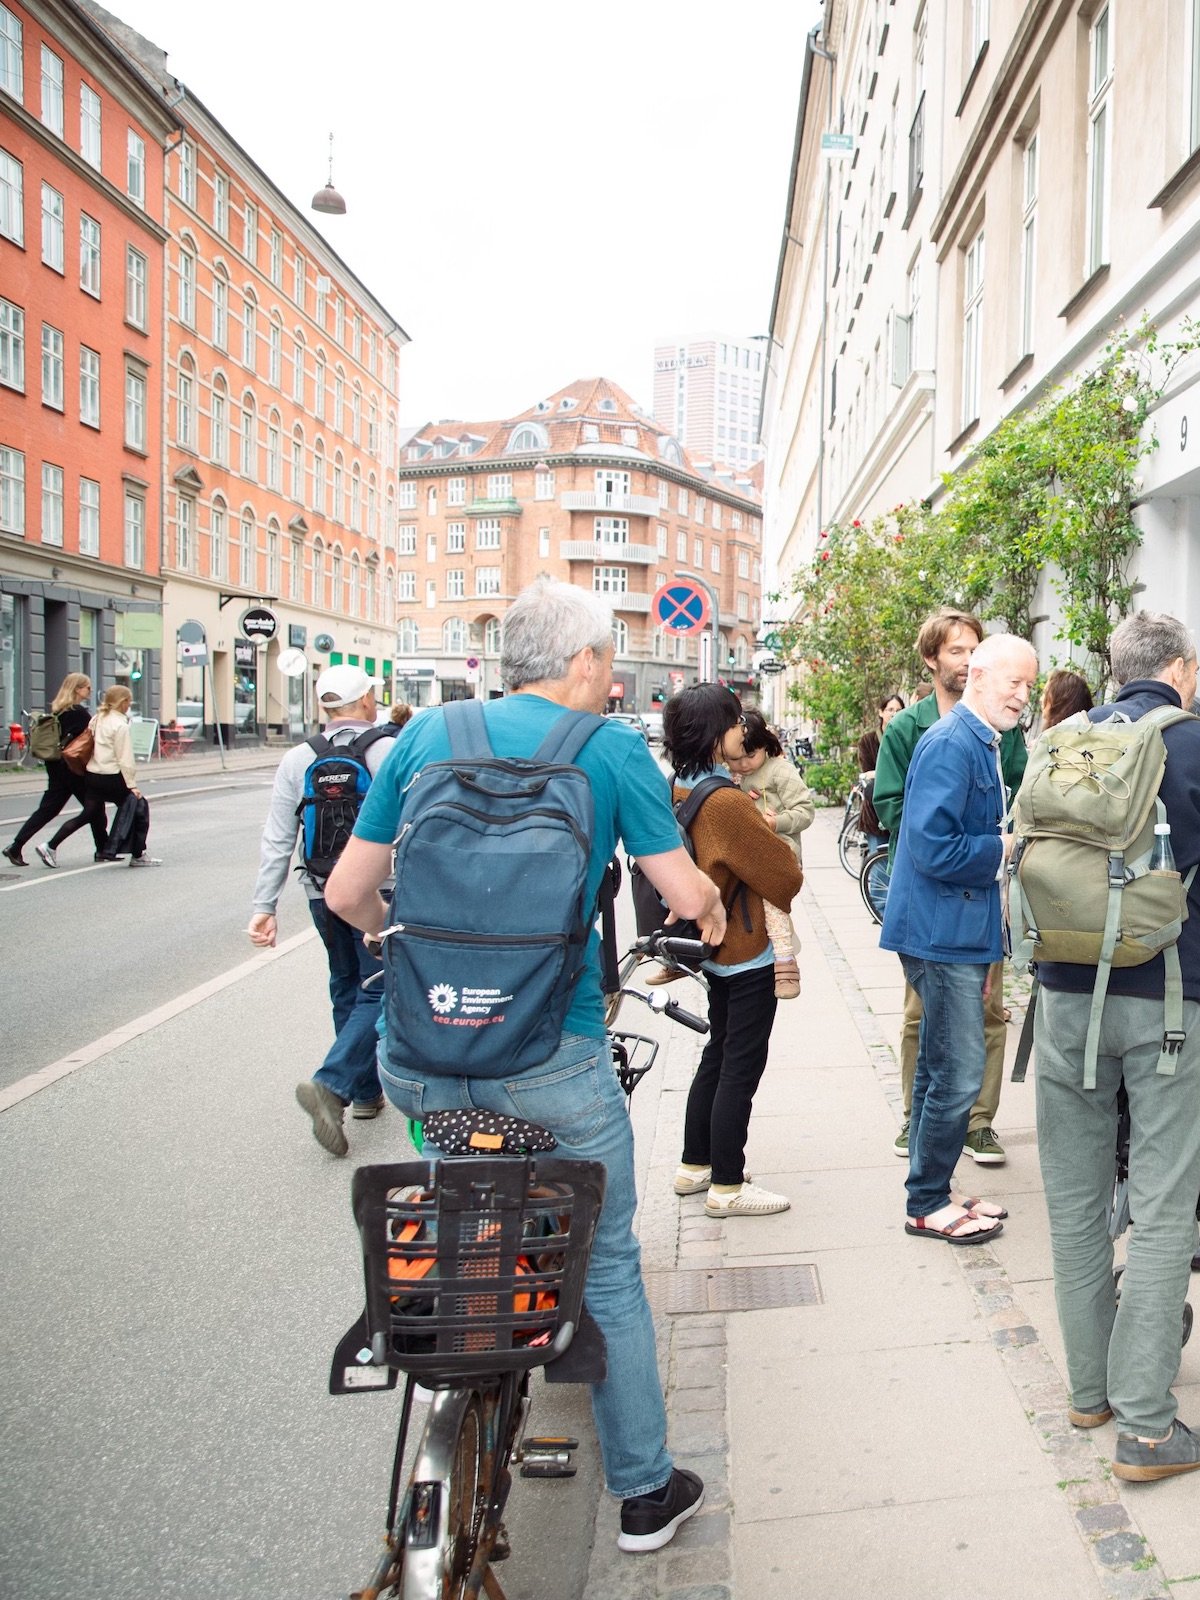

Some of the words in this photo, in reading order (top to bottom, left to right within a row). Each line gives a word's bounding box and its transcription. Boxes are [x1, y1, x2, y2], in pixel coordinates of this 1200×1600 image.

[1180, 415, 1188, 452] 9
[462, 987, 500, 996] European
[462, 995, 514, 1004] Environment
[460, 1005, 491, 1014] Agency
[433, 1015, 505, 1028] eea.europa.eu
